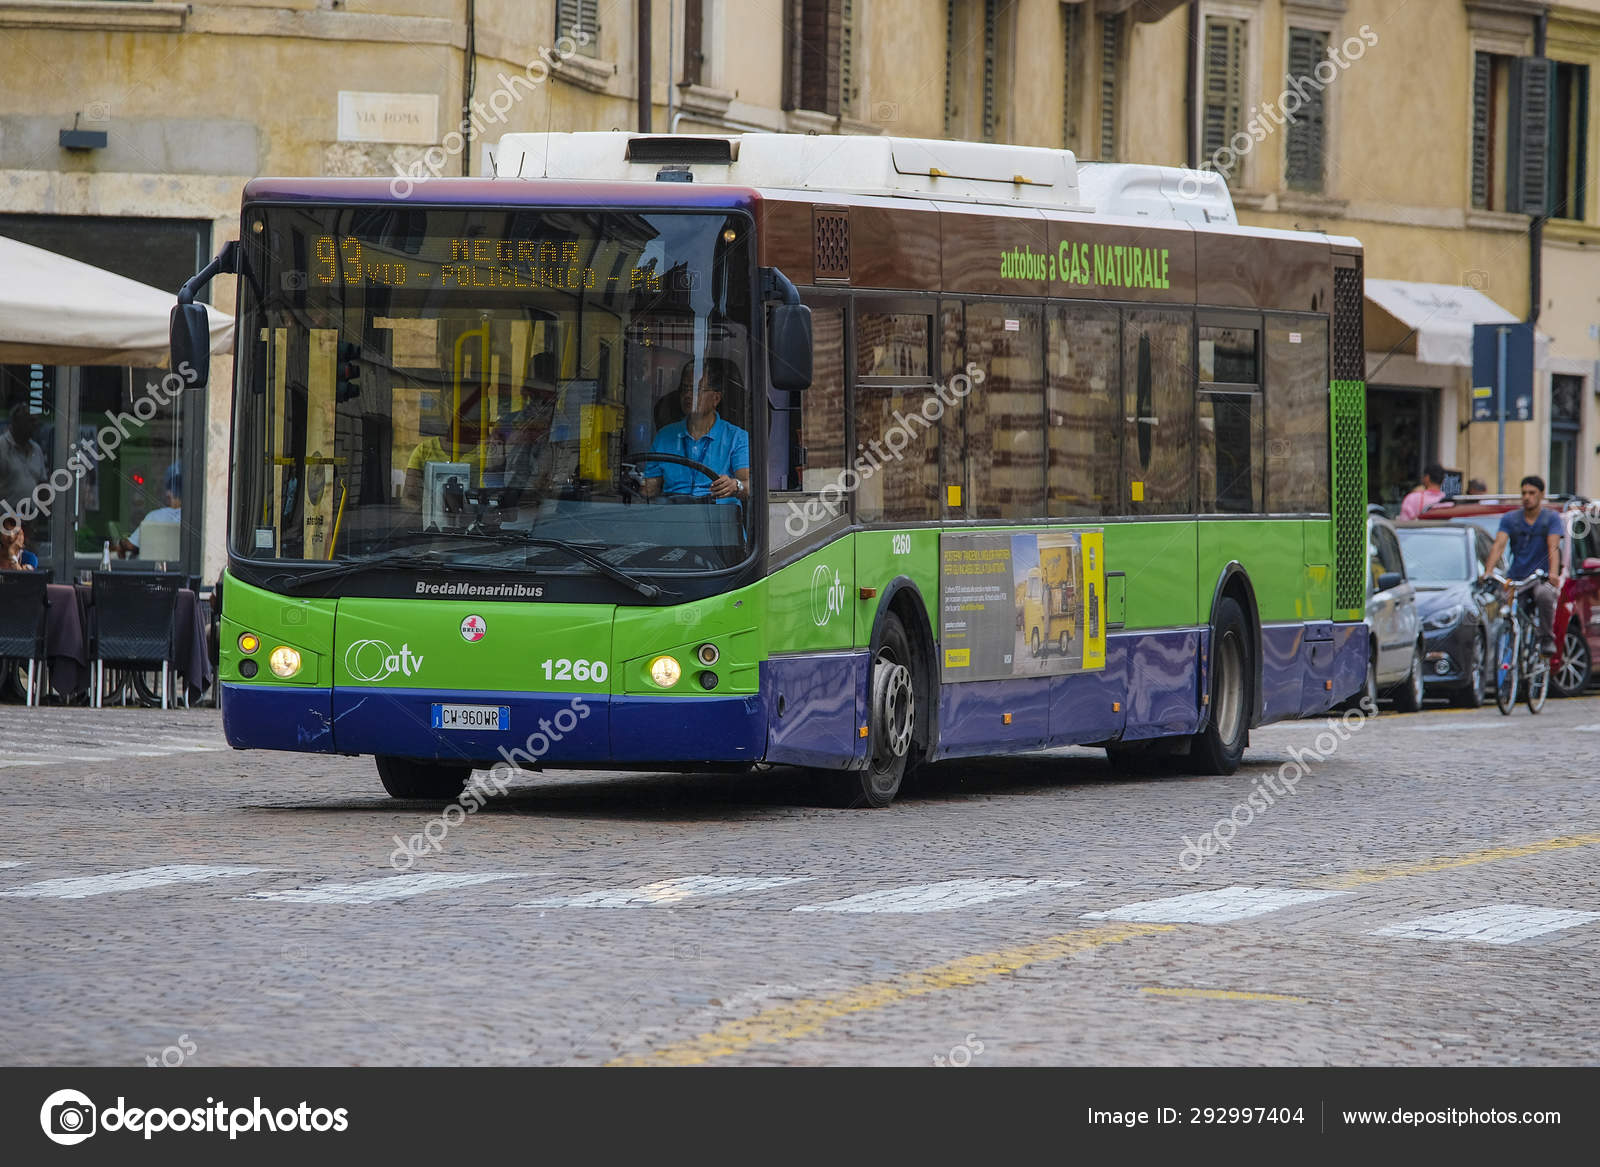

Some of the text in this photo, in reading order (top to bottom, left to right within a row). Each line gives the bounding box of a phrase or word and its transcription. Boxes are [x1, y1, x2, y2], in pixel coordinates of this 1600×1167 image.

[356, 111, 420, 124] VIA ROMA
[316, 237, 362, 284] 93
[452, 239, 580, 262] NEGRAR
[441, 264, 595, 289] POLICLINICO
[1000, 239, 1170, 290] autobus a GAS NATURALE
[892, 534, 911, 555] 1260
[415, 581, 544, 597] BredaMenarinibus
[385, 643, 424, 677] atv
[541, 658, 608, 683] 1260
